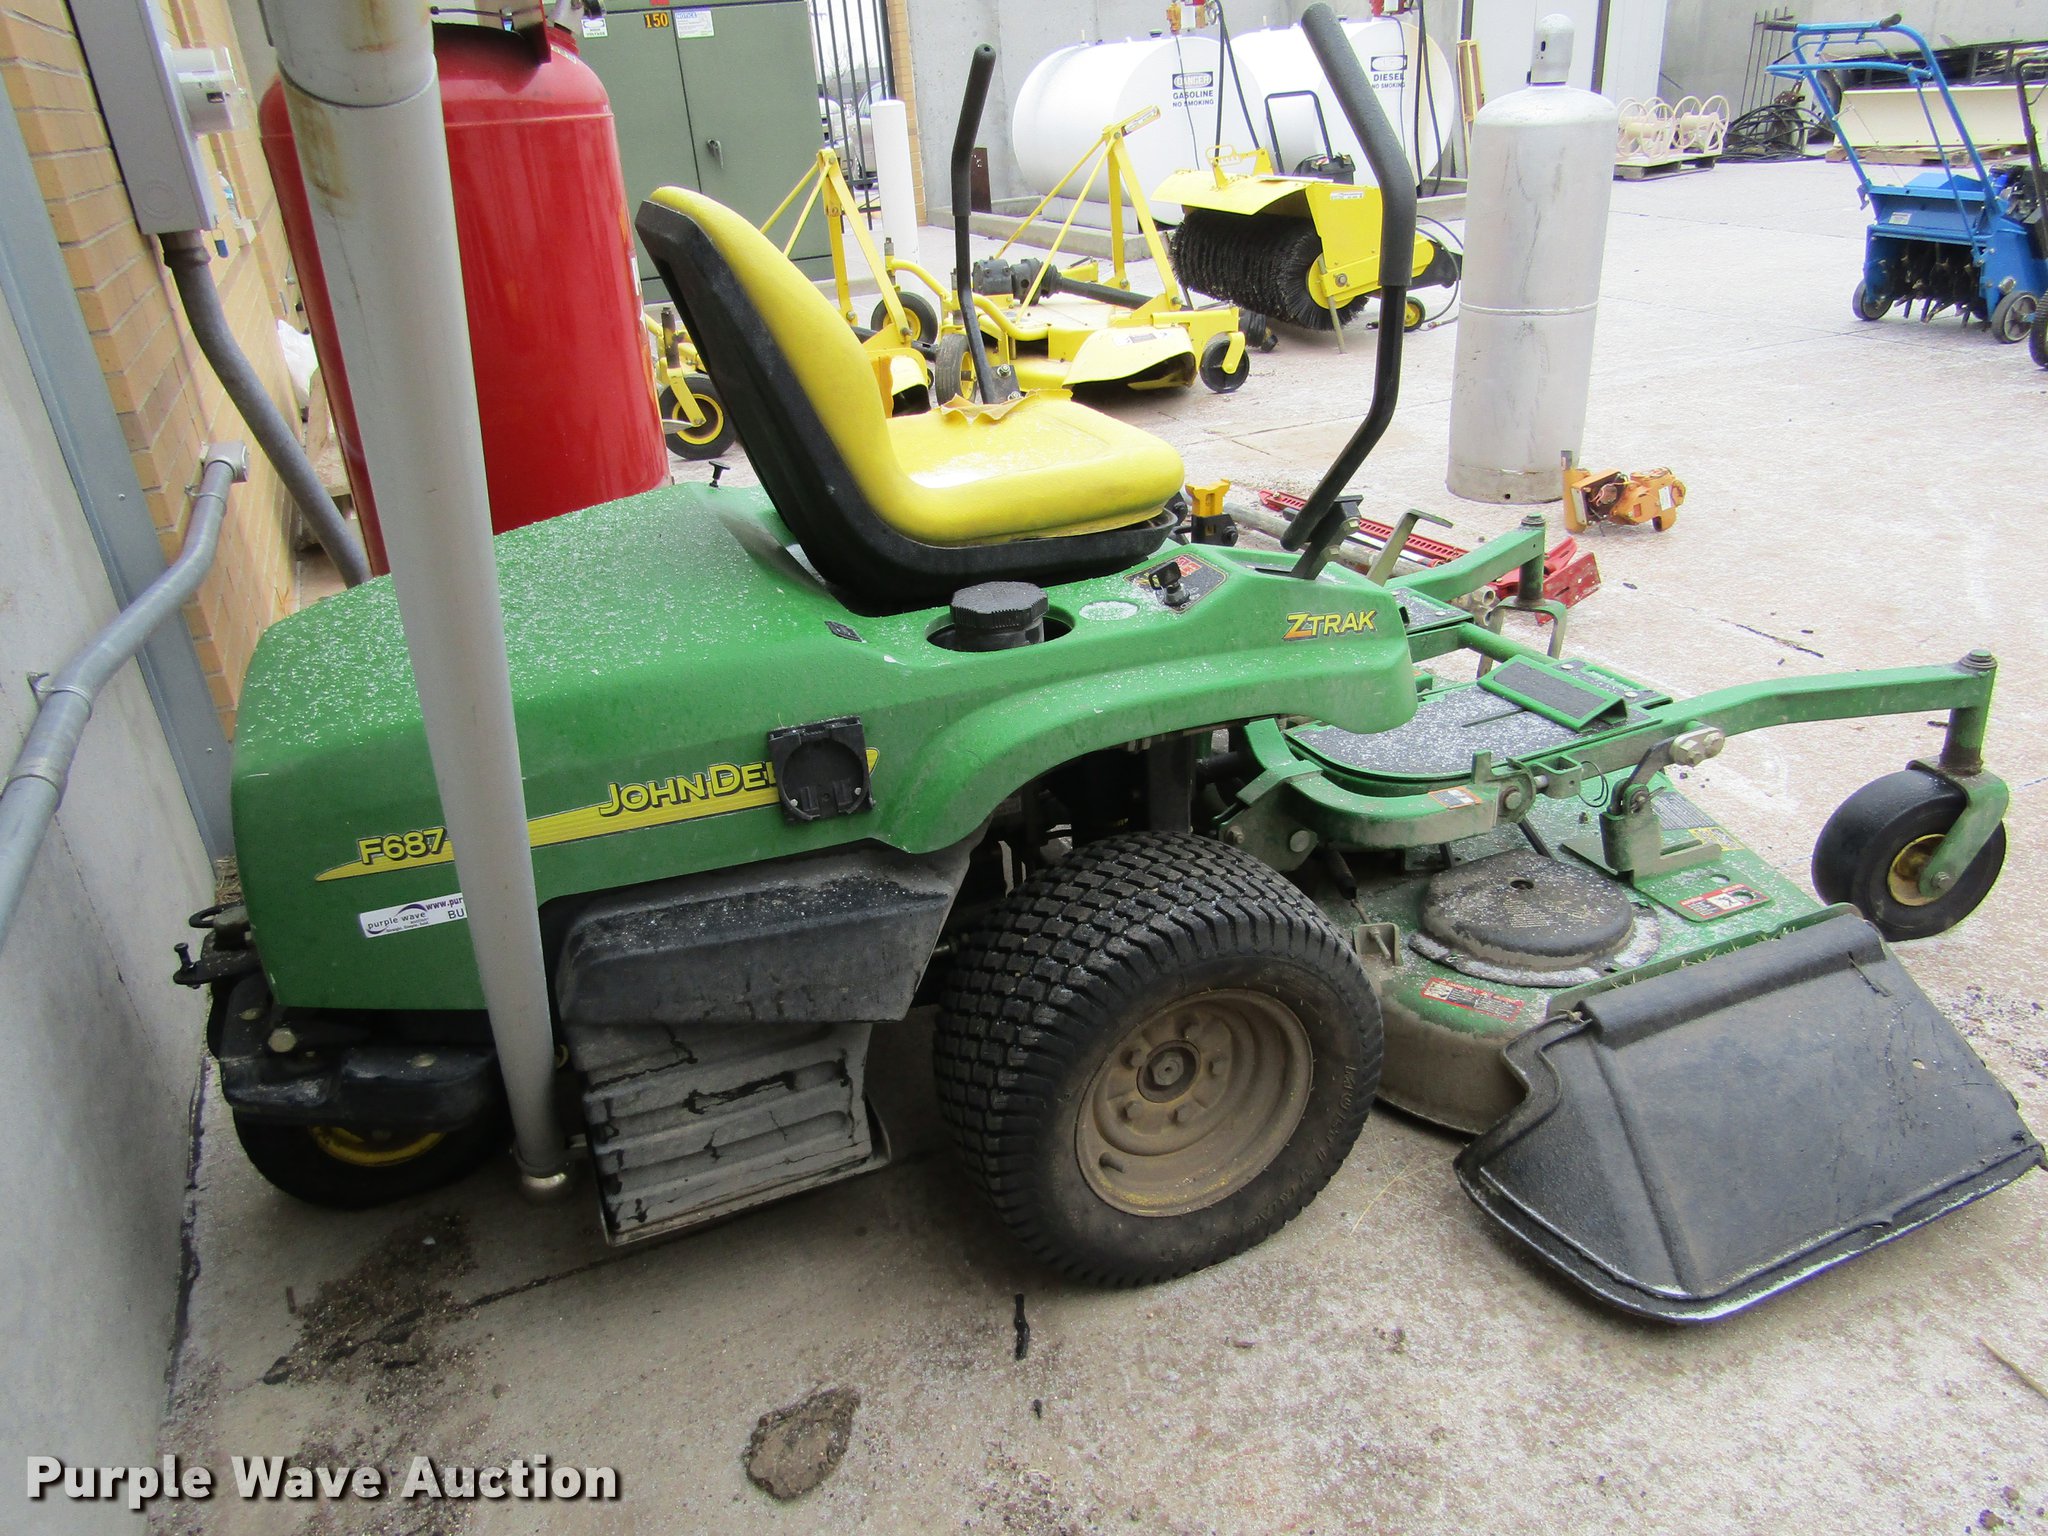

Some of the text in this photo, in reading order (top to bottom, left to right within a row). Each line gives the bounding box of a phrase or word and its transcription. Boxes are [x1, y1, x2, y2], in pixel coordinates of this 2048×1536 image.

[644, 12, 669, 29] 150
[1373, 73, 1404, 82] DIESEL
[1172, 90, 1214, 100] GASOLINE
[1184, 99, 1214, 107] SMOKING
[1282, 610, 1377, 640] ZTRAK
[599, 772, 709, 817] JOHN
[358, 826, 447, 865] F687
[425, 897, 463, 910] www.pur
[367, 917, 398, 930] purple
[401, 911, 426, 921] wave
[447, 908, 465, 920] BU
